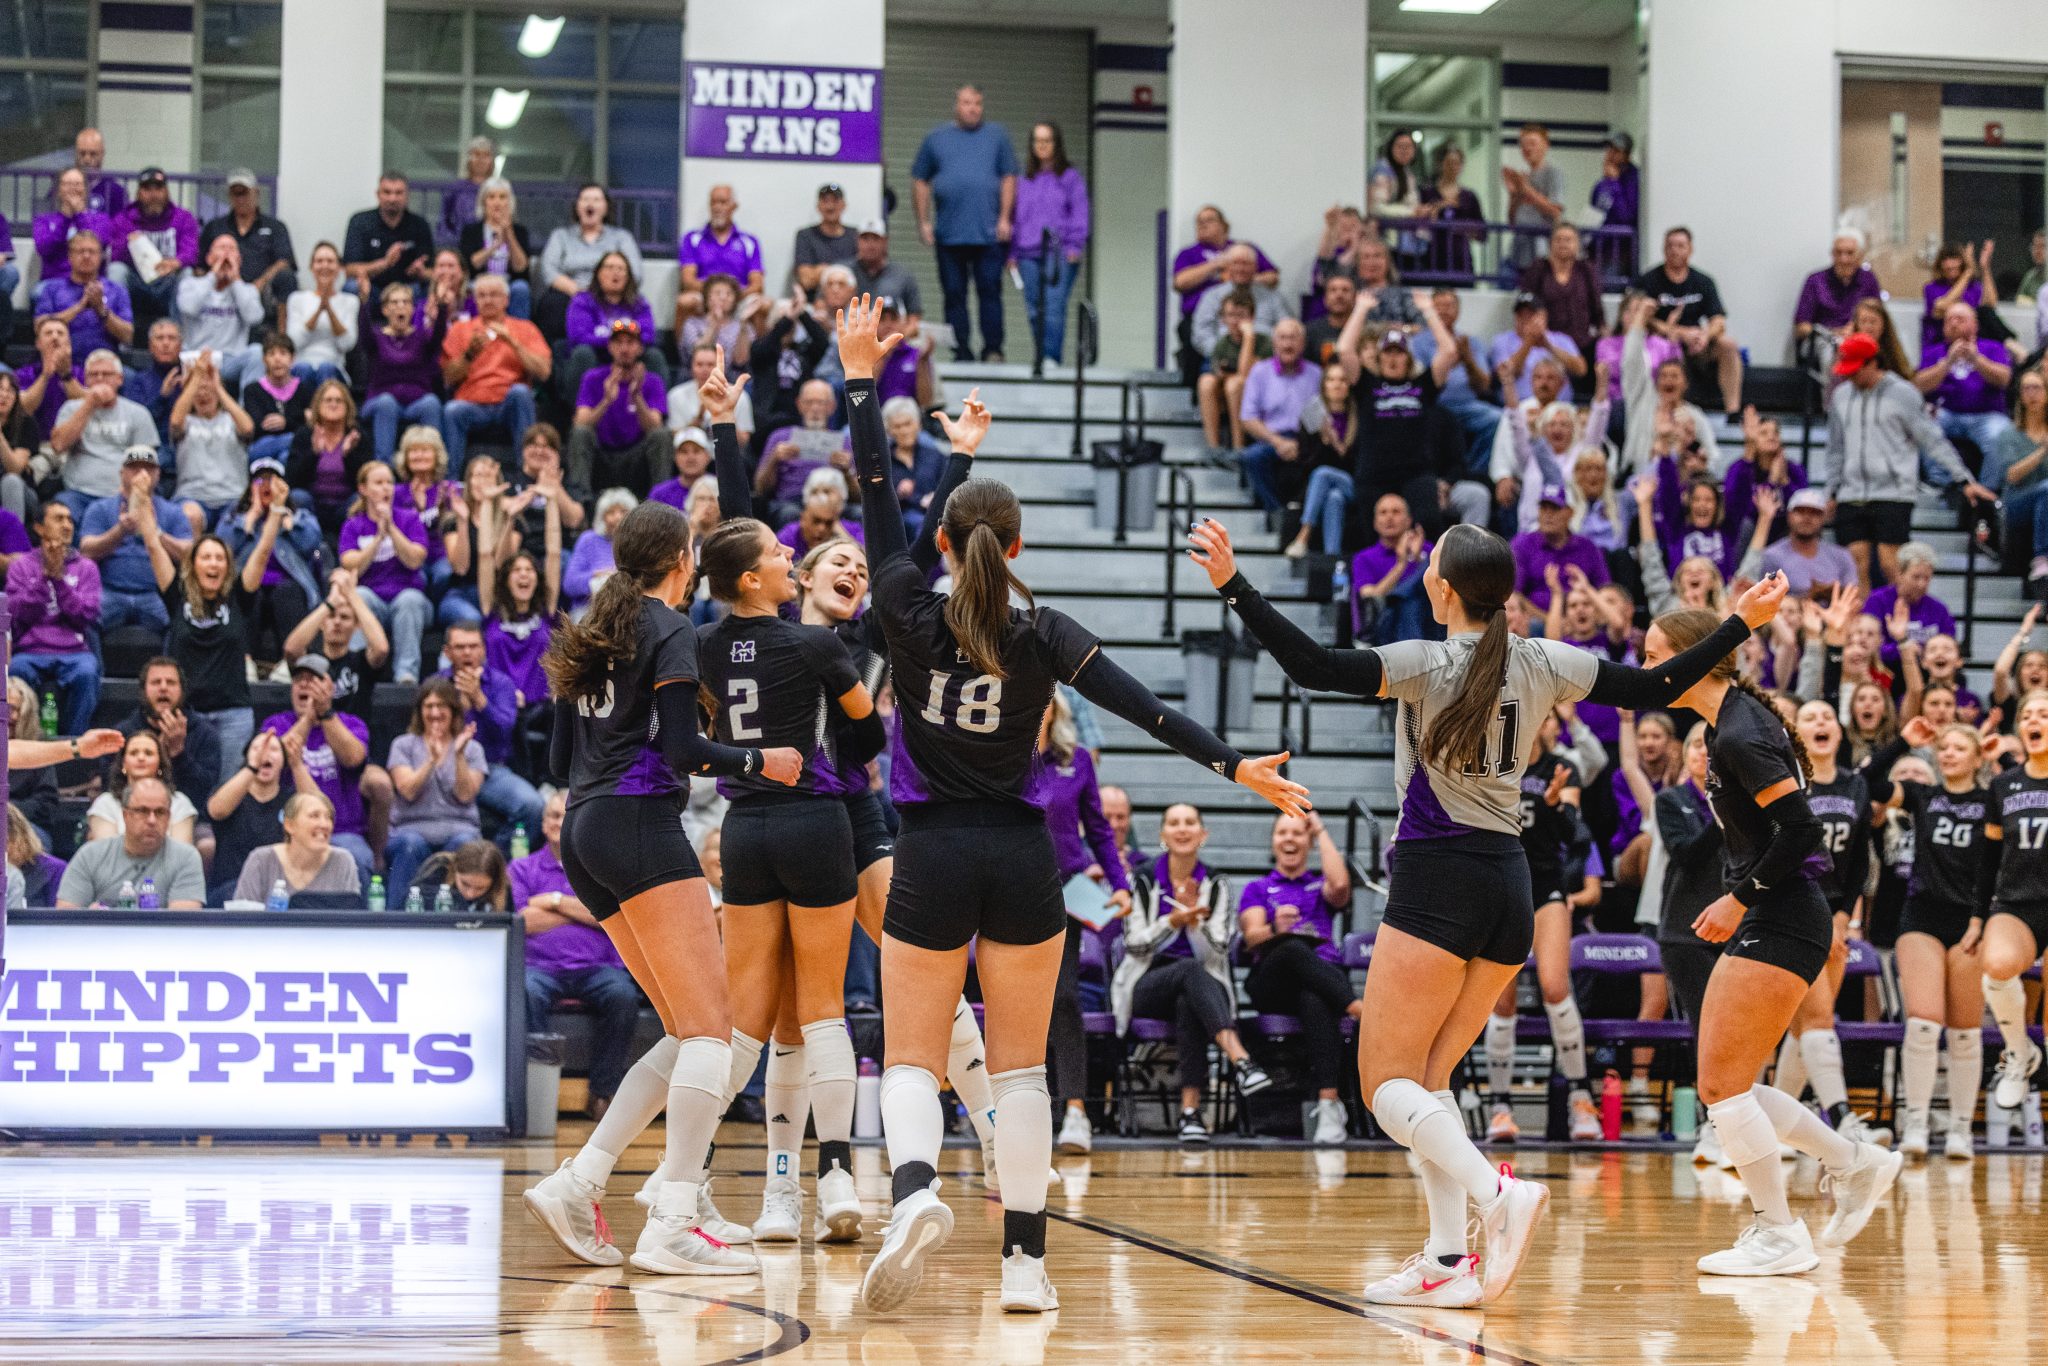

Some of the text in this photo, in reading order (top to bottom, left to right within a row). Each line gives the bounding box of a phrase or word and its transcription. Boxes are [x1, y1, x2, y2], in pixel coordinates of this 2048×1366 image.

[692, 67, 875, 112] MINDEN
[725, 114, 841, 156] FANS
[728, 679, 762, 740] 2
[921, 669, 1002, 733] 18
[2018, 816, 2048, 849] 17
